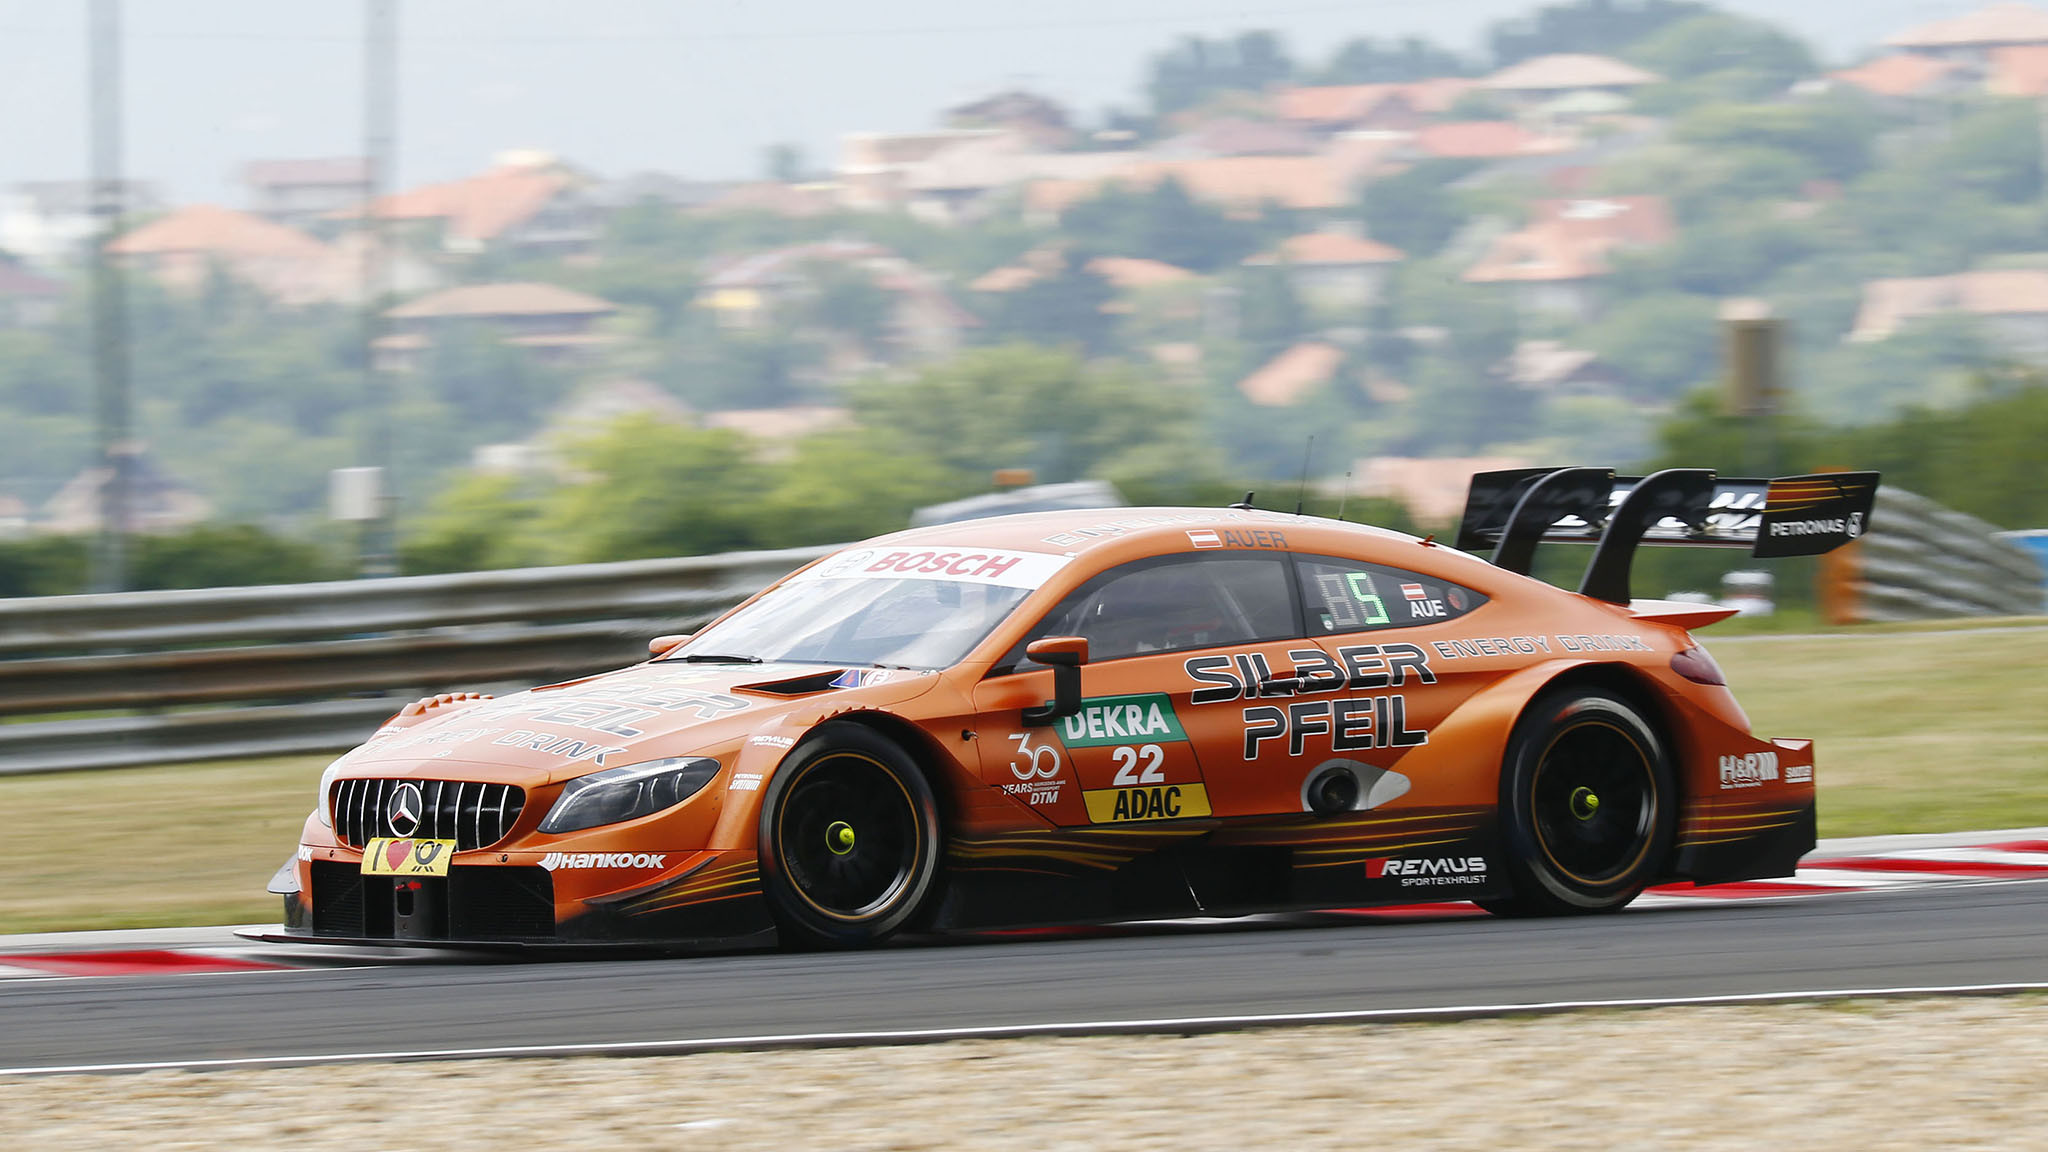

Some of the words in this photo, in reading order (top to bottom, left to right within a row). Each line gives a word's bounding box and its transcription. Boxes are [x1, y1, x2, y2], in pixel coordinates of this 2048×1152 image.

[1224, 529, 1289, 549] AUER
[1770, 518, 1845, 537] PETRONAS
[864, 551, 1023, 578] BOSCH
[1410, 599, 1447, 618] AUE
[1430, 636, 1552, 660] ENERGY
[1554, 634, 1655, 652] DRINK
[1183, 642, 1438, 705] SILBER
[1064, 702, 1171, 740] DEKRA
[1243, 694, 1429, 761] PFEIL
[491, 729, 629, 767] DRINK
[1008, 733, 1061, 781] 30
[1112, 744, 1165, 786] 22
[1002, 782, 1034, 795] YEARS
[1030, 791, 1059, 805] DTM
[1112, 786, 1182, 821] ADAC
[1381, 857, 1487, 876] REMUS
[1401, 875, 1487, 887] SPORTEXHAUST
